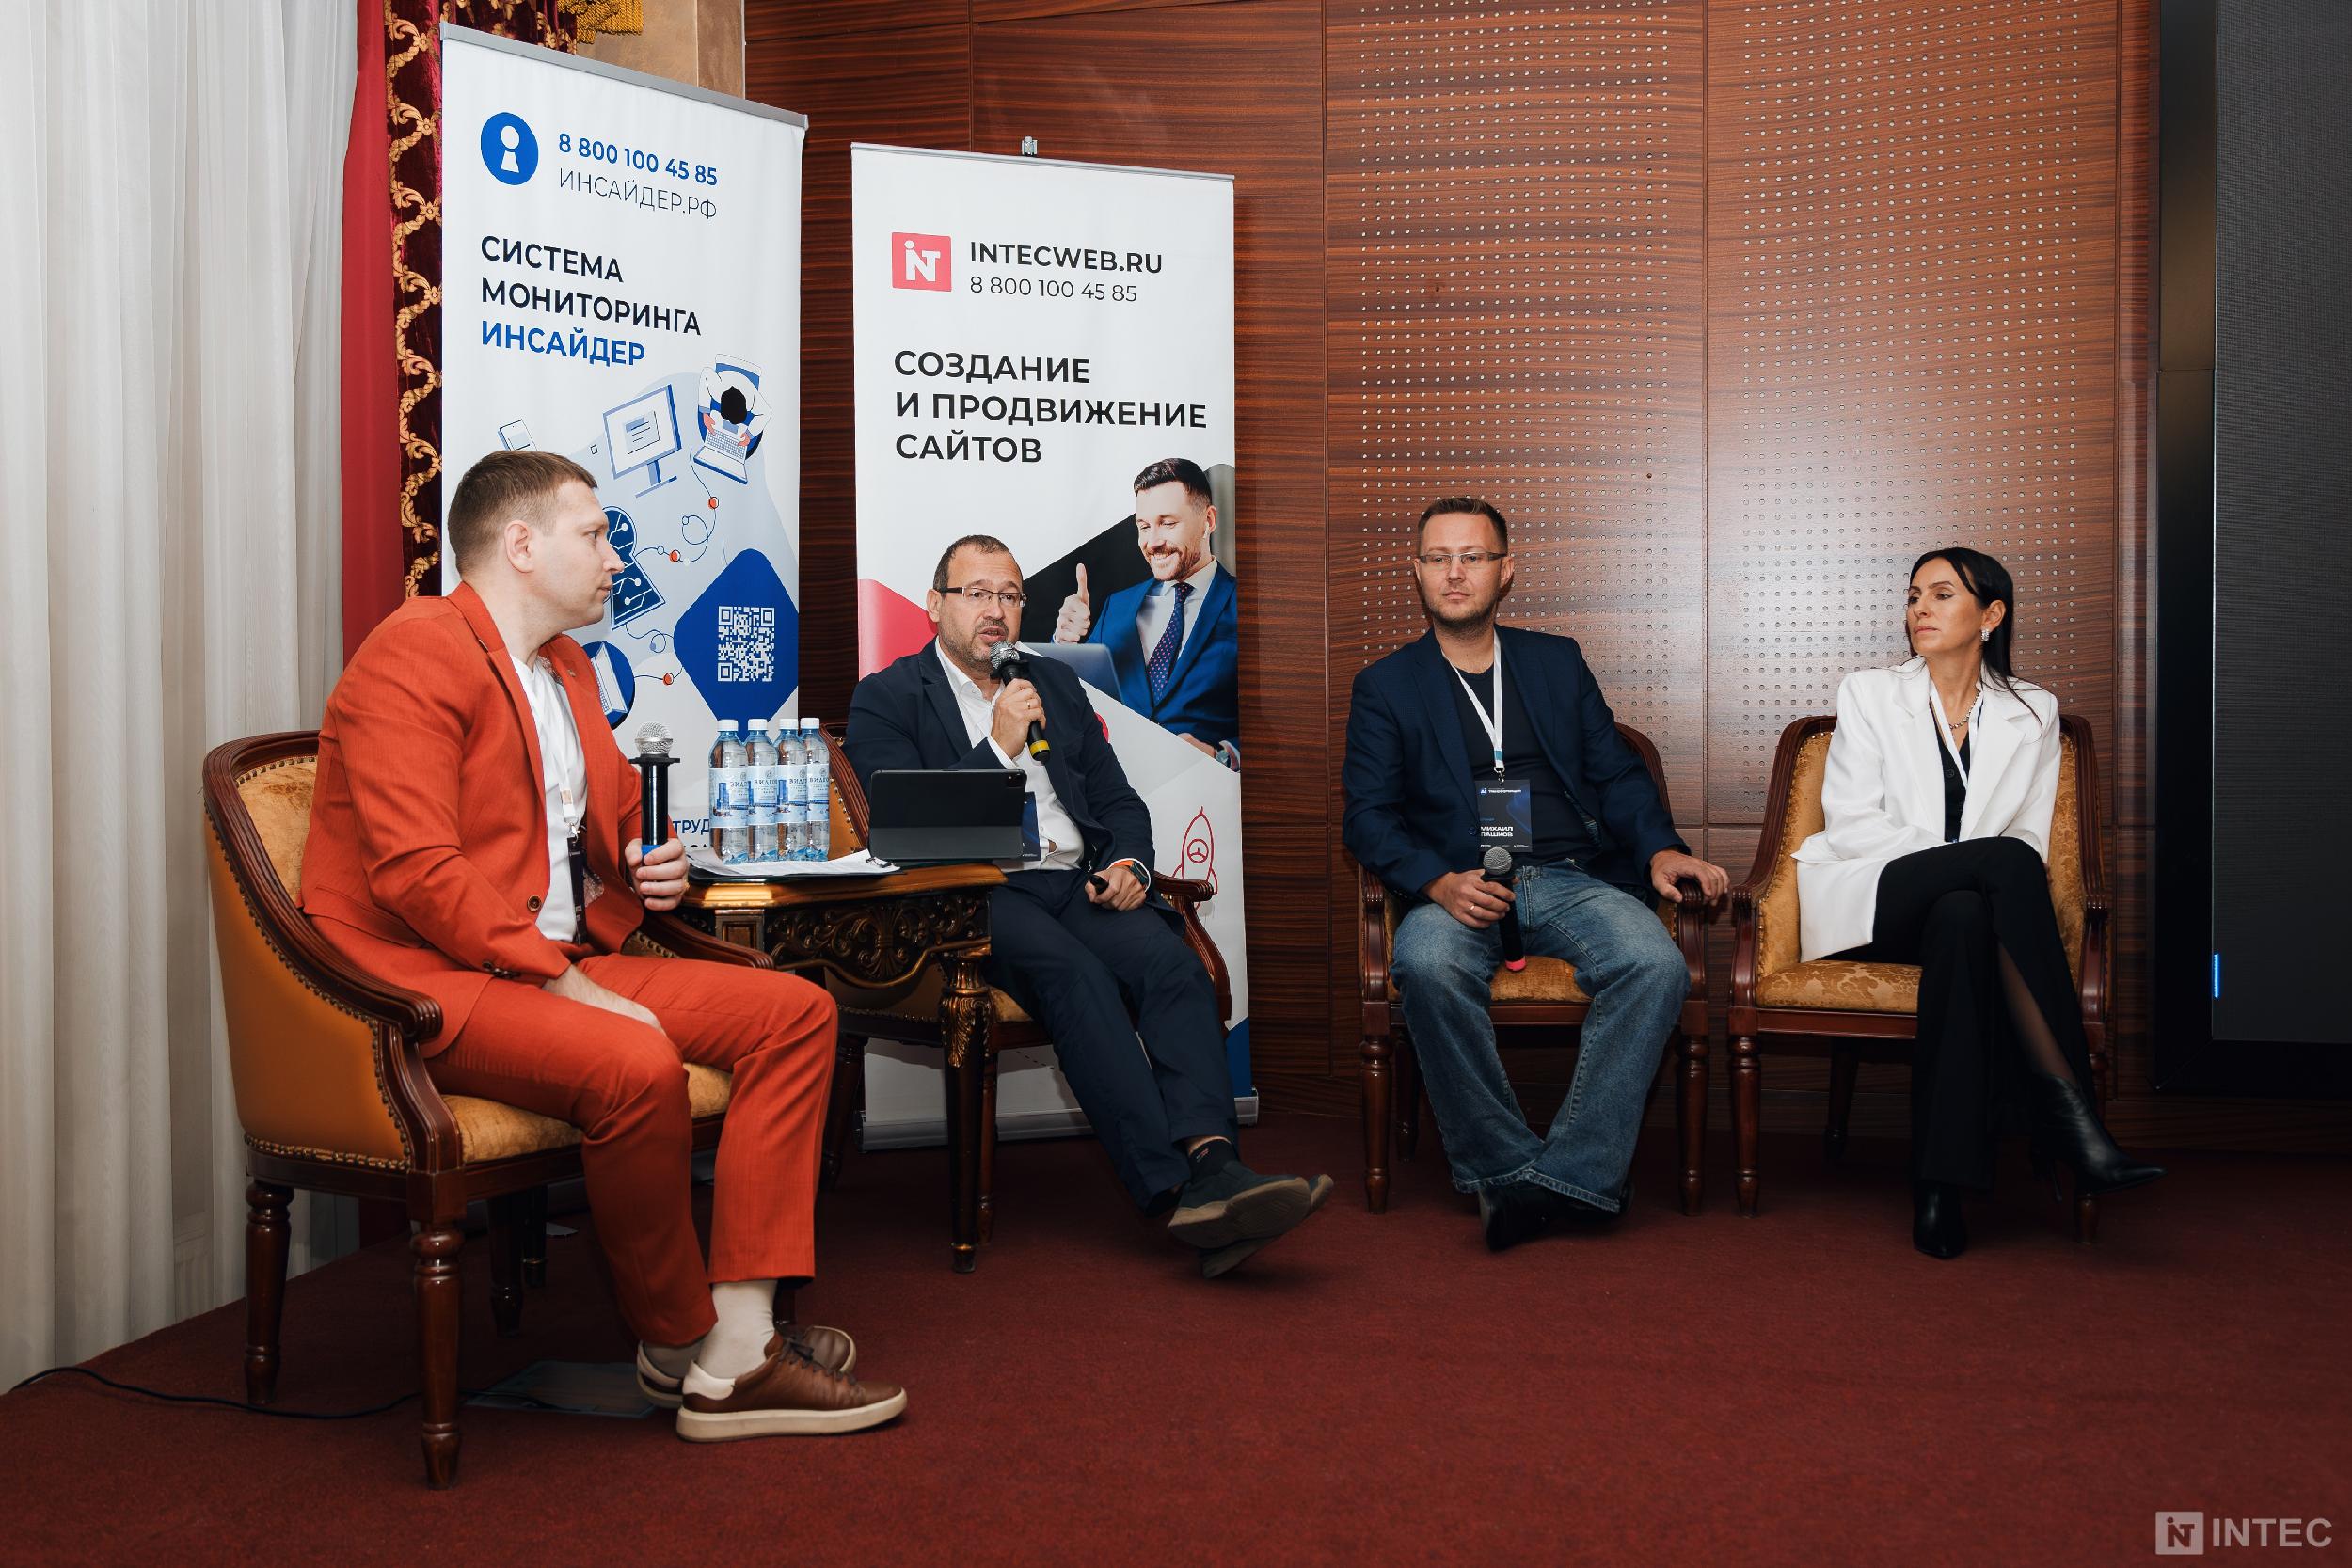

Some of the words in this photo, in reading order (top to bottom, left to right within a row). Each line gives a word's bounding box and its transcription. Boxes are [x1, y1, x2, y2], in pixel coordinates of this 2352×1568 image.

[558, 133, 571, 153] 8
[578, 137, 618, 165] 800
[624, 148, 660, 173] 100
[664, 158, 690, 181] 45
[694, 164, 718, 186] 85
[559, 167, 717, 220] ИНСАЙДЕР.РФ
[481, 235, 625, 283] СИСТЕМА
[970, 241, 1163, 275] INTECWEB.RU
[482, 277, 702, 337] МОНИТОРИНГА
[970, 276, 983, 293] 8
[990, 277, 1032, 296] 800
[1038, 279, 1074, 298] 100
[1080, 281, 1105, 301] 45
[1111, 284, 1137, 303] 85
[482, 320, 645, 368] ИНСАЙДЕР
[894, 350, 1090, 385] СОЗДАНИЕ
[896, 391, 919, 418] И
[932, 393, 1207, 429] ПРОДВИЖЕНИЕ
[896, 429, 1042, 463] САЙТОВ
